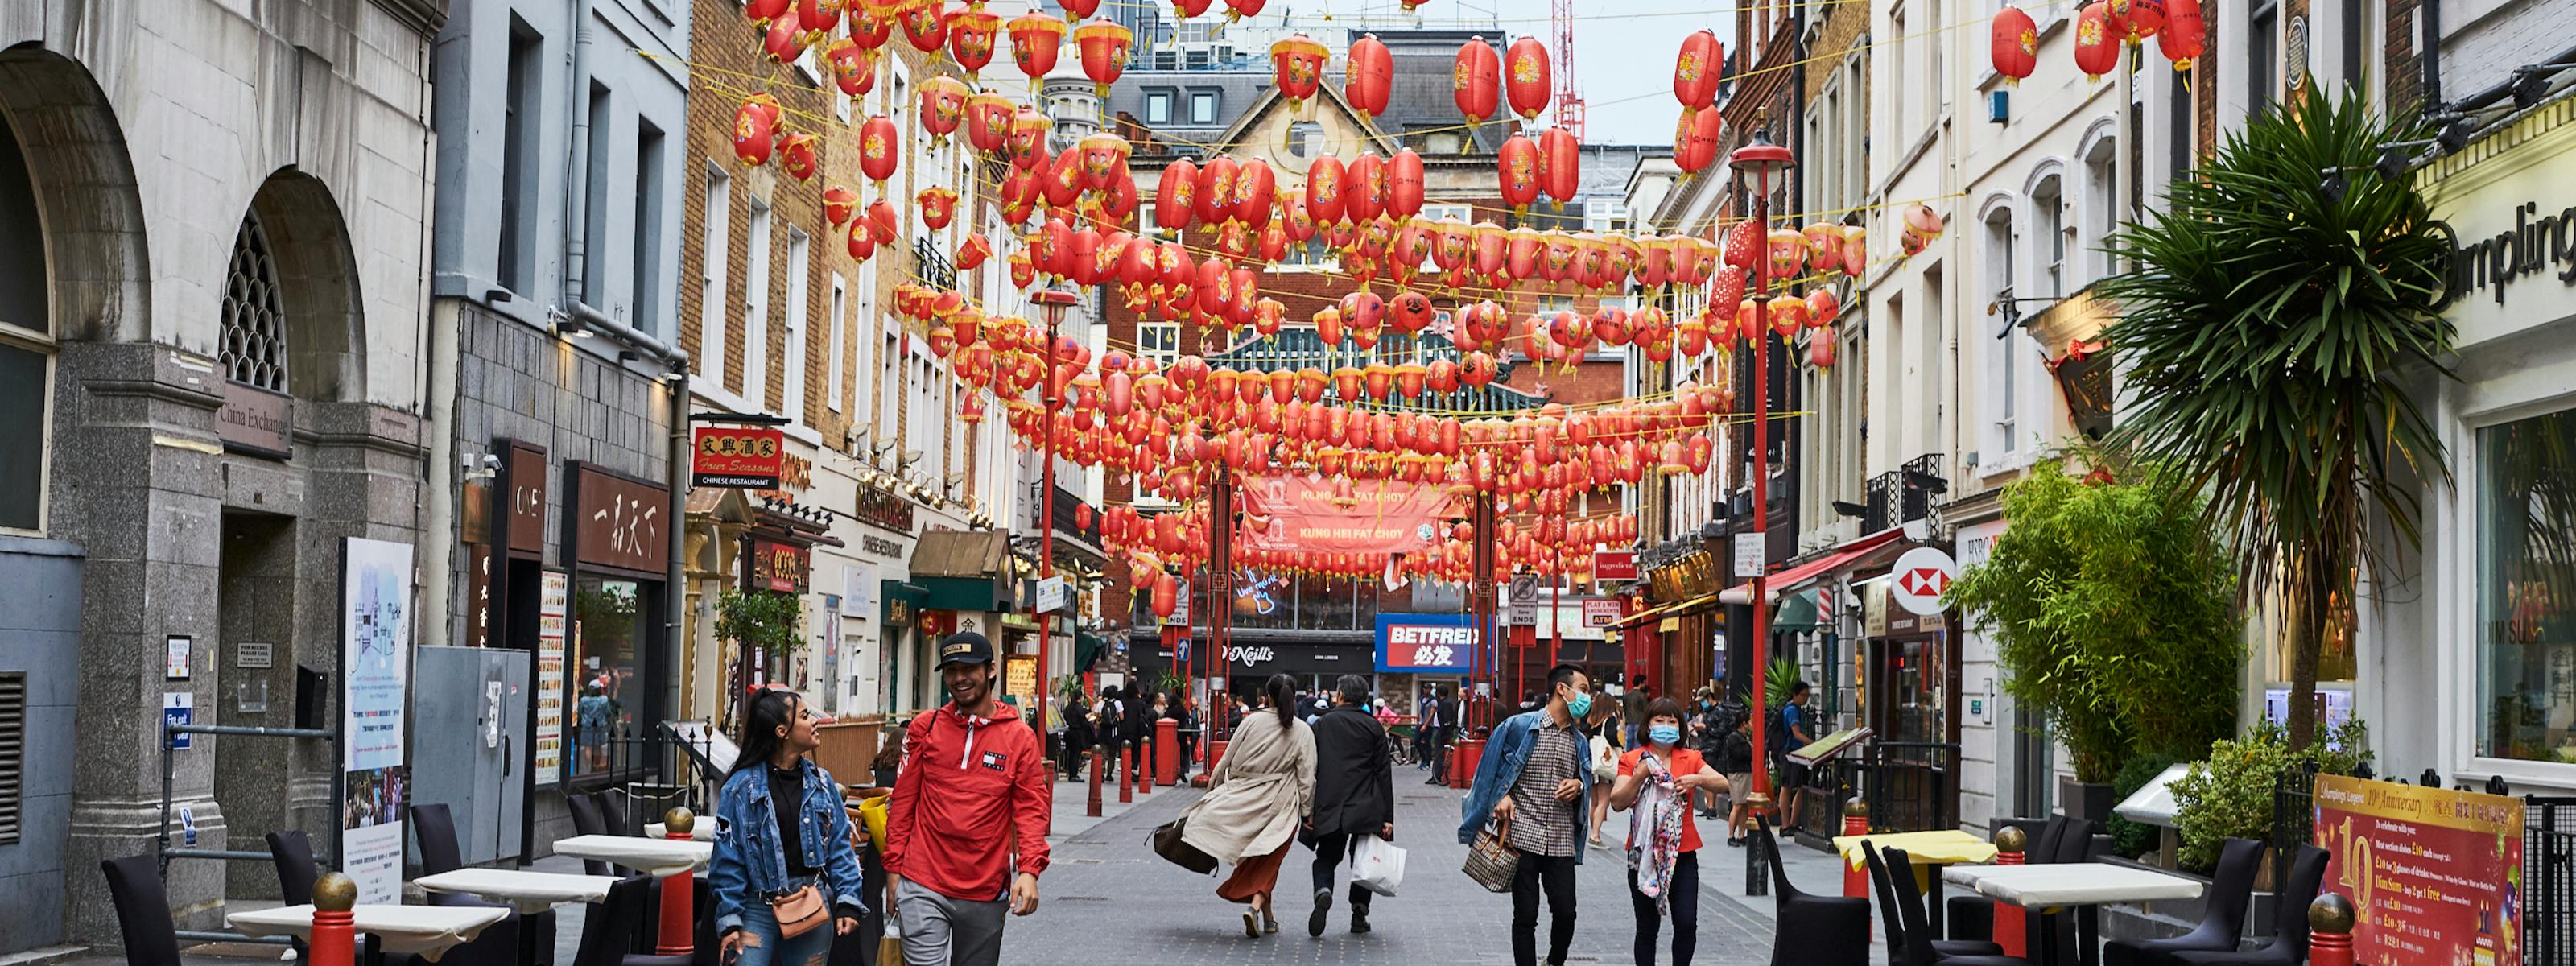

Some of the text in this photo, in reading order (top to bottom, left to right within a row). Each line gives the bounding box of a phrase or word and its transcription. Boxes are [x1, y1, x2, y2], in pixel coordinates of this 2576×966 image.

[220, 402, 287, 440] China Exchange
[702, 437, 774, 456] 文興酒家
[698, 456, 775, 473] Four Seasons
[702, 477, 770, 486] CHINESE RESTAURANT
[1300, 489, 1331, 501] KUNG
[1355, 491, 1373, 502] FAT
[593, 493, 658, 560] 一品天下
[1300, 528, 1404, 539] KUNG HEI FAT CHOY
[1968, 535, 1989, 566] HSBC
[1254, 575, 1278, 590] music
[1594, 616, 1612, 624] ATM
[1390, 626, 1480, 644] BETFRED
[1413, 645, 1454, 667] 必发
[2380, 789, 2422, 819] Anniversary
[2412, 841, 2423, 857] £10
[2339, 815, 2372, 908] 10
[2376, 855, 2386, 869] £10
[2376, 874, 2388, 890] Dim
[2388, 877, 2402, 894] Sum
[2427, 885, 2441, 902] free
[2357, 907, 2369, 925] Old
